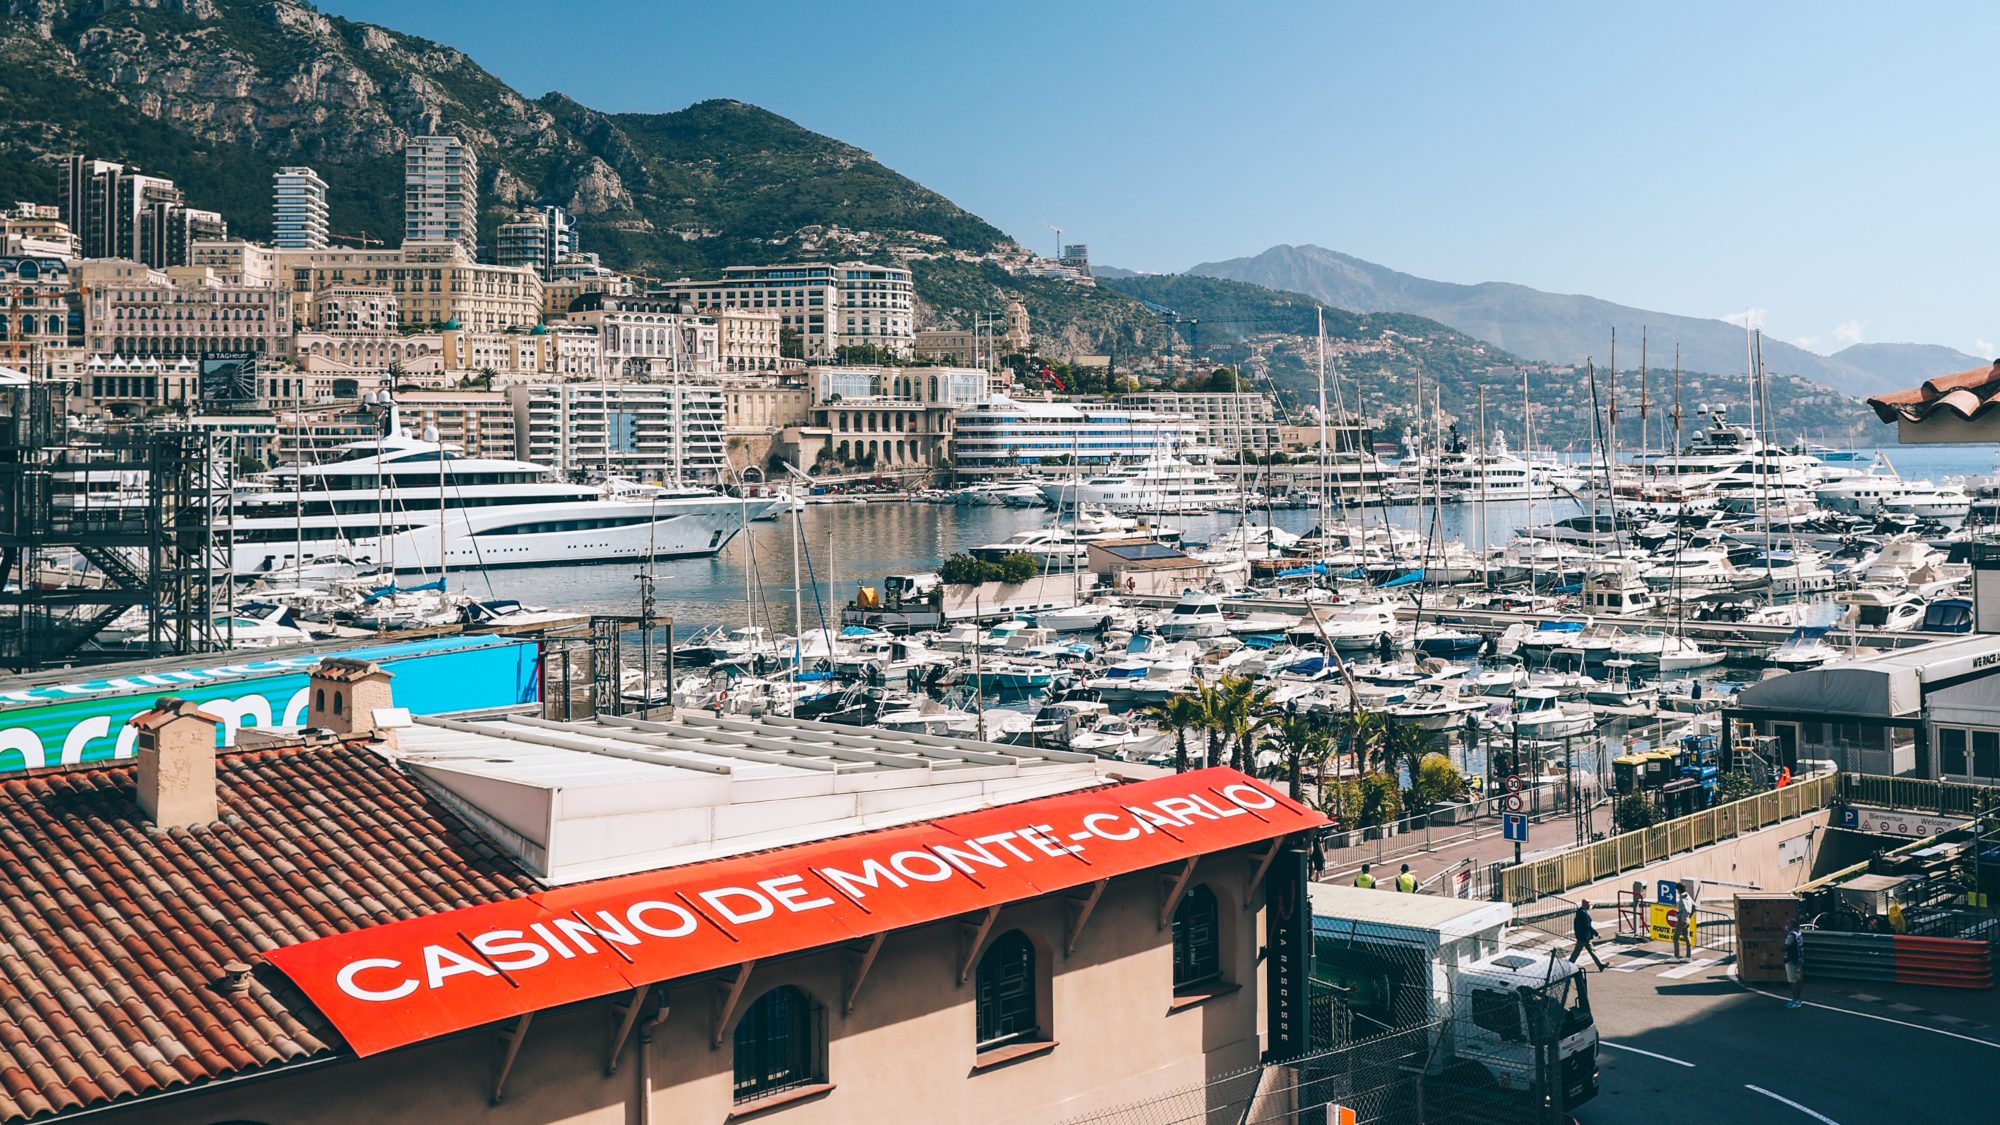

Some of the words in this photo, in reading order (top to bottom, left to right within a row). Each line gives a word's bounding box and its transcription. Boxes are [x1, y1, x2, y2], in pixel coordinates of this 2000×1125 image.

[1845, 812, 1853, 822] P
[1869, 812, 1904, 823] Bienvenue
[1921, 817, 1952, 828] Welcome
[336, 900, 698, 1002] CASINO
[698, 874, 836, 925] DE
[820, 784, 1276, 899] MONTE-CARLO
[1661, 884, 1669, 896] P
[1280, 928, 1287, 946] LA
[1280, 955, 1288, 1041] RASCASSE
